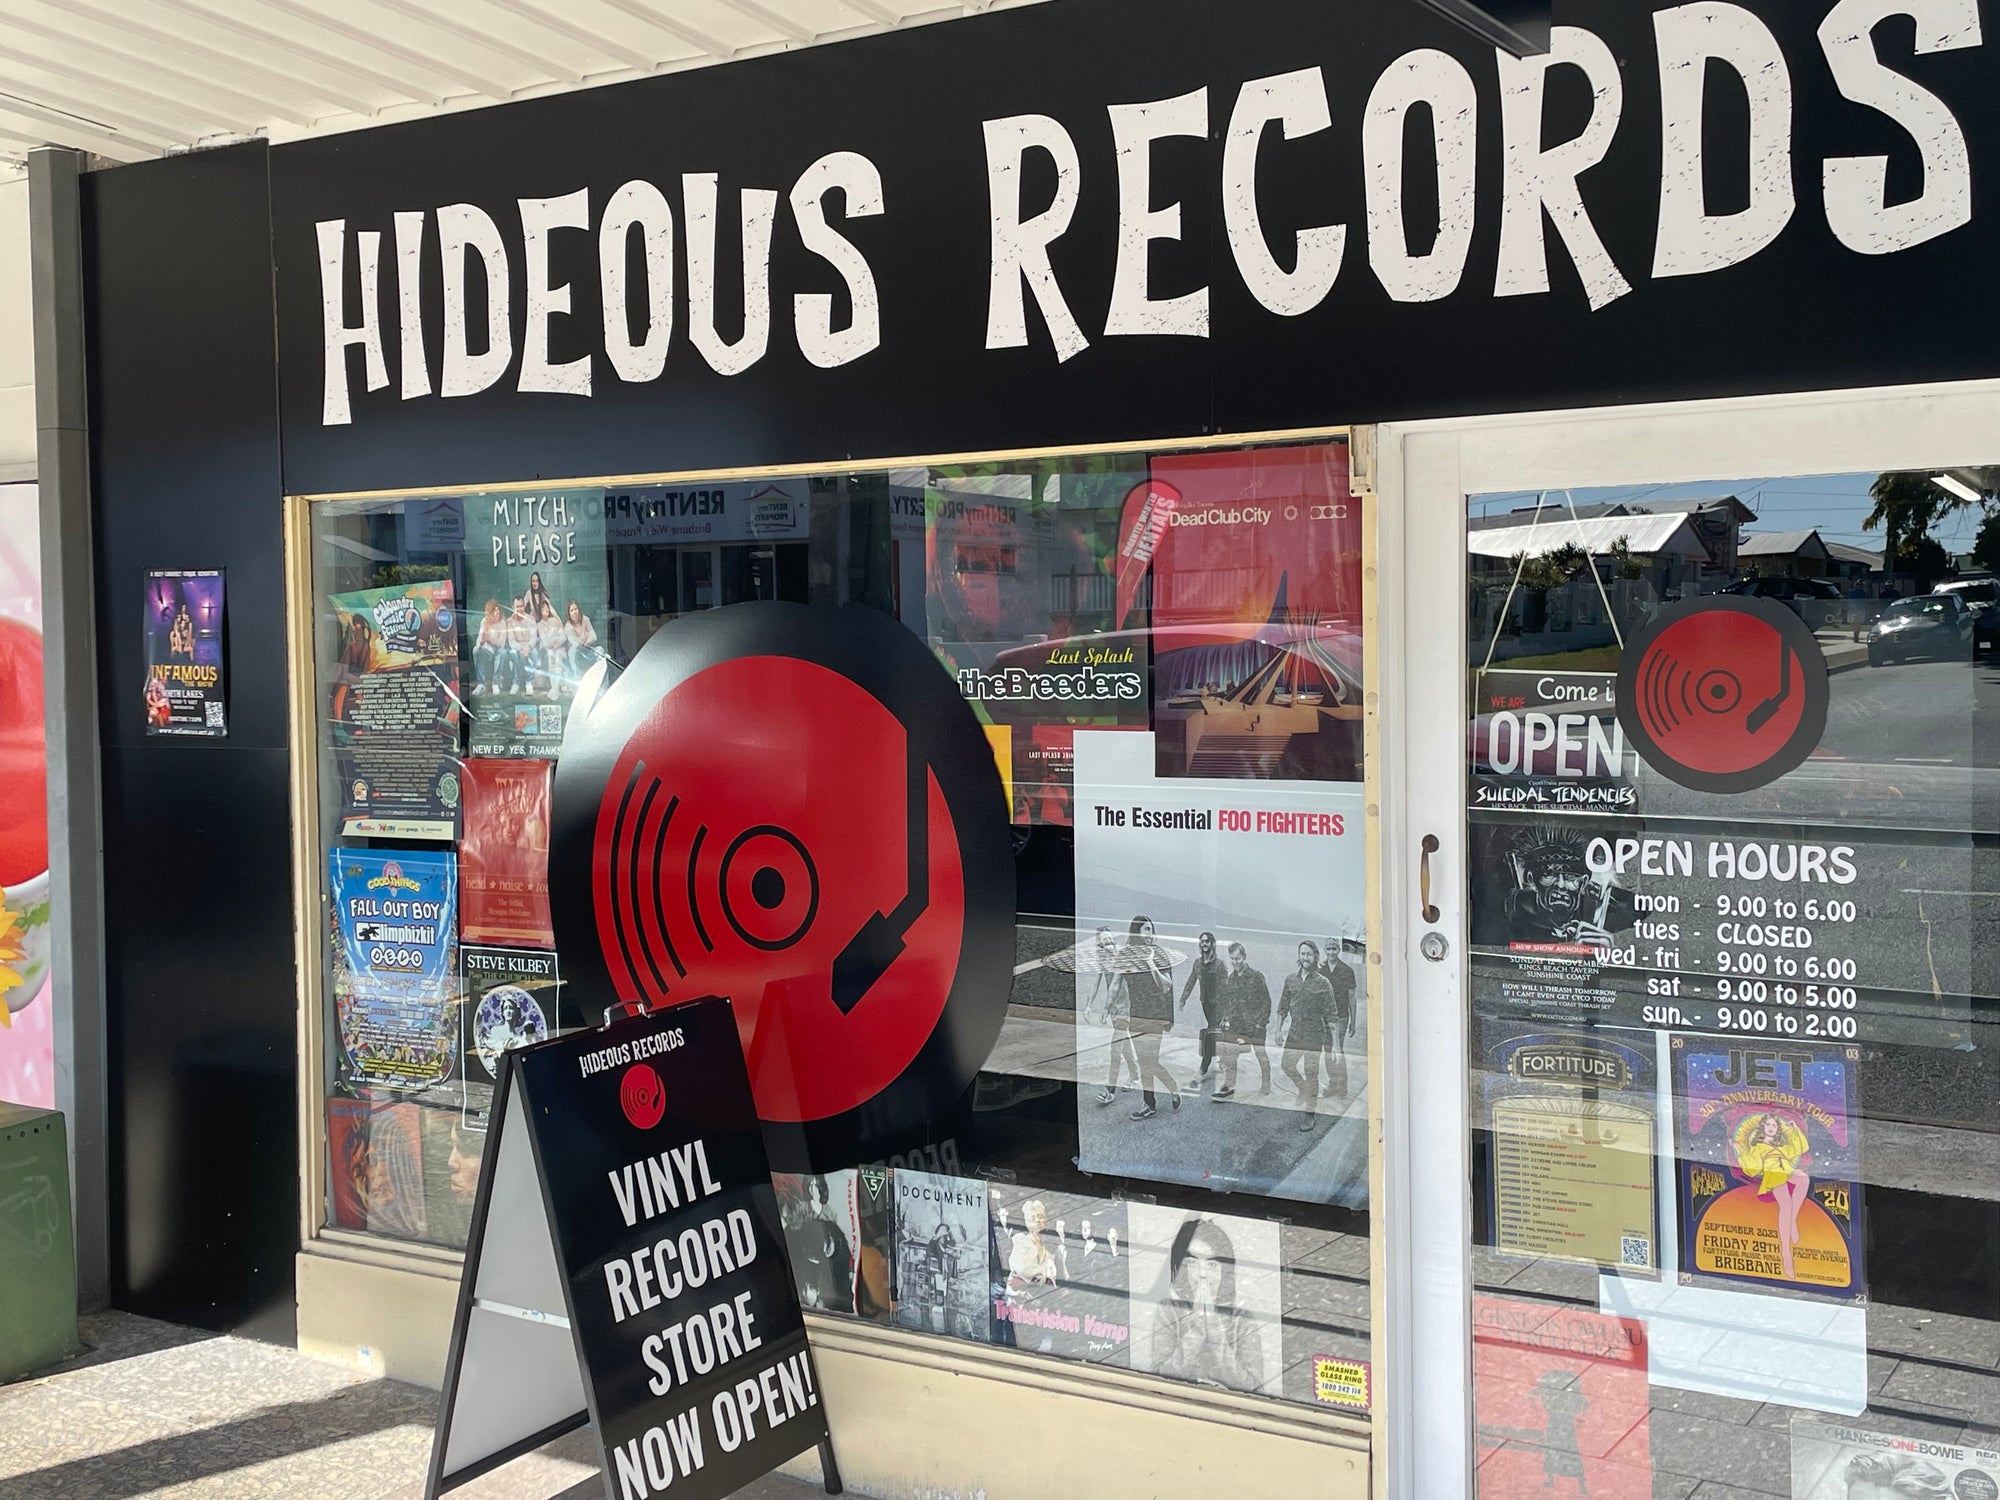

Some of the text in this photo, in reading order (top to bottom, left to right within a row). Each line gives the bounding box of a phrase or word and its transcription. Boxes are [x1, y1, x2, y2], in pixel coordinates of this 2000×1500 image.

[315, 0, 1982, 425] HIDEOUS RECORDS
[494, 496, 575, 527] MITCH,
[1170, 507, 1271, 527] Dead Club City
[1134, 496, 1176, 562] RENTALS
[493, 531, 577, 567] PLEASE
[1045, 647, 1134, 668] Last Splash
[150, 665, 217, 681] INFAMOUS
[958, 667, 1141, 699] theBreeders
[182, 690, 204, 698] LAKES
[1537, 677, 1616, 702] Come i
[1491, 697, 1525, 708] WE ARE
[473, 744, 492, 754] NEW
[494, 744, 504, 754] EP
[509, 745, 526, 755] YES,
[1488, 711, 1624, 776] OPEN
[1475, 785, 1636, 806] SUICIDAL TENDENCIES
[1586, 804, 1617, 812] MANIAC
[1094, 806, 1345, 836] The Essential FOO FIGHTERS
[1585, 837, 1857, 885] OPEN HOURS
[368, 878, 420, 892] GOOD THINGS
[499, 878, 523, 892] noise
[350, 898, 440, 920] FALL OUT BOY
[1634, 894, 1857, 922] mon 9.00 to 6.00
[380, 924, 435, 945] limpbizkit
[1633, 919, 1812, 948] tues CLOSED
[370, 947, 423, 967] DEVO
[467, 954, 551, 974] STEVE KILBEY
[1560, 958, 1608, 968] NOVEMBER
[1594, 945, 1857, 980] wed fri 9.00 to 6.00
[1527, 971, 1564, 979] SUNSHINE
[1647, 976, 1857, 1009] sat 9.00 to 5.00
[1642, 1004, 1857, 1038] sun 9.00 to 2.00
[578, 1027, 685, 1078] HIDEOUS RECORDS
[1672, 1039, 1683, 1048] 20
[1846, 1049, 1858, 1059] 03
[1522, 1055, 1616, 1079] FORTITUDE
[1714, 1050, 1813, 1091] JET
[1722, 1090, 1836, 1128] ANNIVERSARY TOUR
[608, 1139, 721, 1227] VINYL
[870, 1179, 878, 1192] 5
[902, 1185, 982, 1208] DOCUMENT
[1704, 1222, 1778, 1238] SEPTEMBER 2023
[1703, 1235, 1780, 1253] FRIDAY 29TH
[1703, 1247, 1740, 1257] FORTITUDE
[604, 1208, 757, 1323] RECORD
[1715, 1256, 1781, 1275] BRISBANE
[1855, 1294, 1867, 1305] 23
[994, 1300, 1128, 1344] Transvision Vamp
[1480, 1305, 1643, 1347] GENESIS OWUSU
[642, 1291, 762, 1396] STORE
[1320, 1371, 1342, 1381] GLASS
[1344, 1376, 1362, 1384] RING
[1324, 1365, 1358, 1376] SMASHED
[1322, 1382, 1337, 1391] 1800
[1338, 1385, 1350, 1393] 242
[614, 1350, 817, 1500] NOW OPEN!
